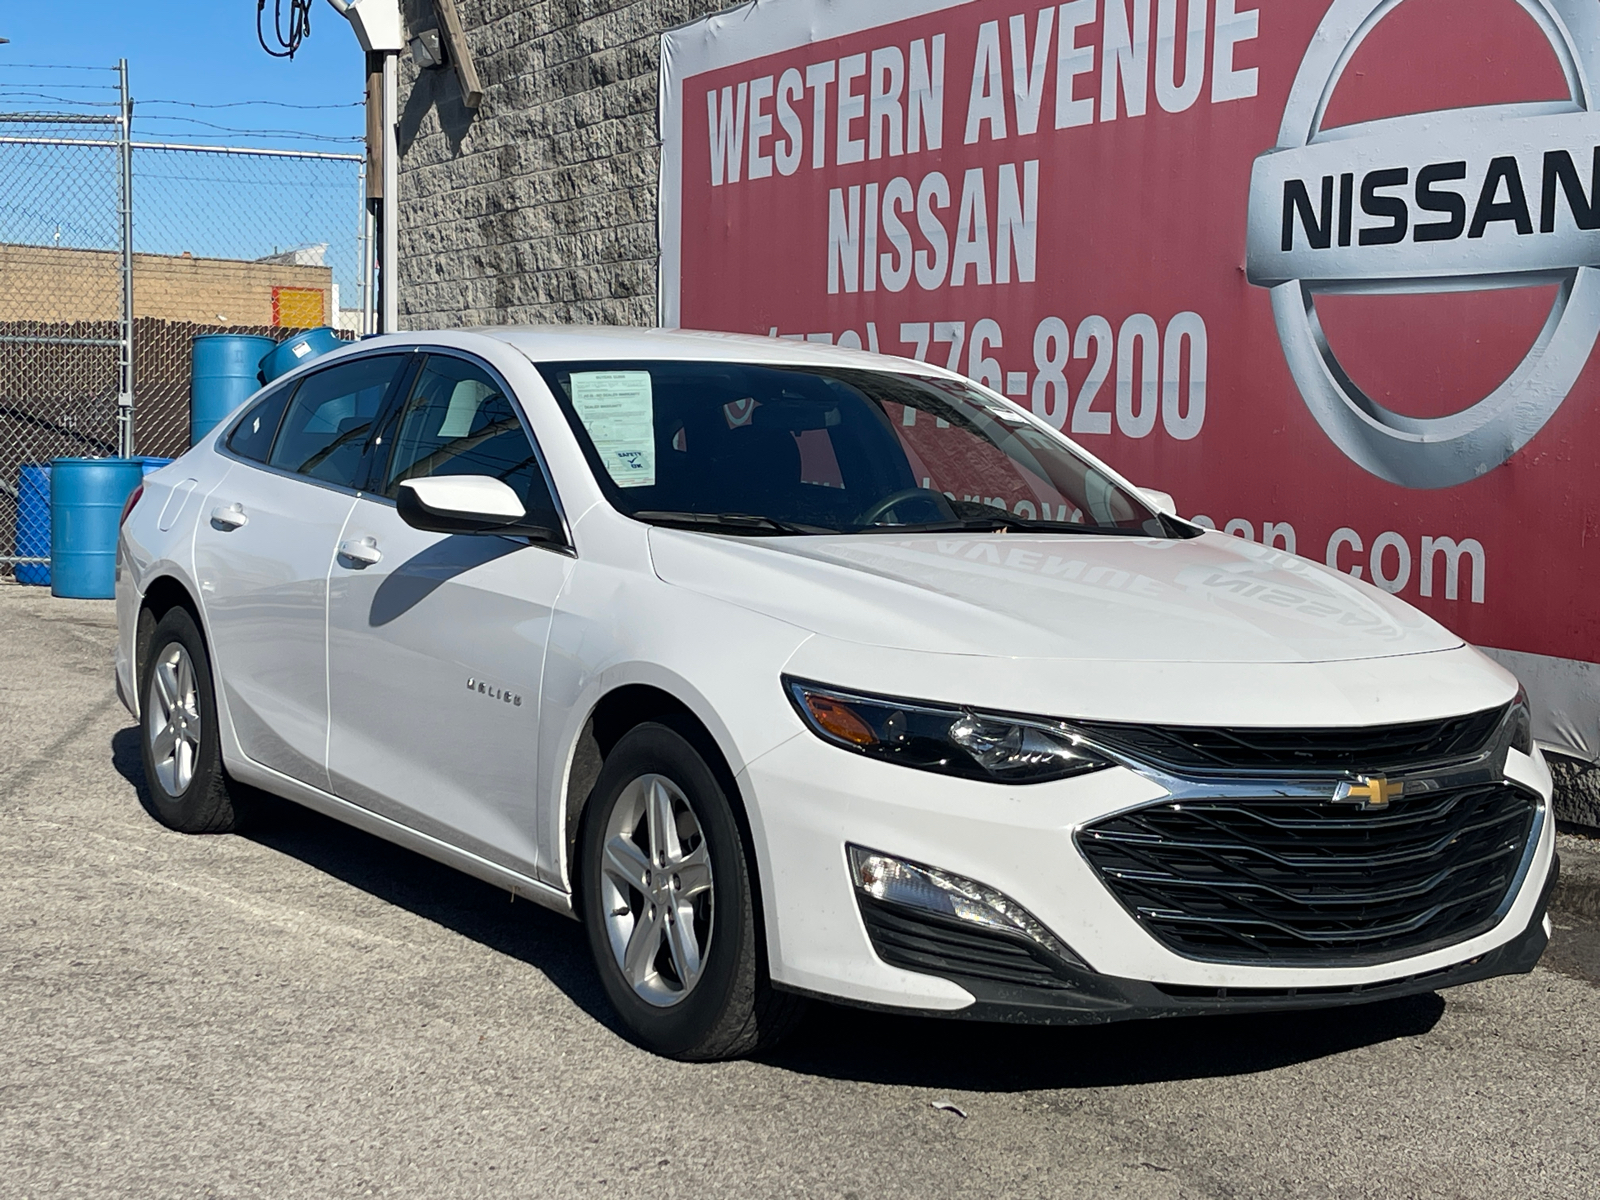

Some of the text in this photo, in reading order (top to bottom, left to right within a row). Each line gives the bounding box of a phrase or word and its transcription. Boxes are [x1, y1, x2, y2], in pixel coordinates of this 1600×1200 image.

[707, 0, 1259, 187] WESTERN AVENUE
[828, 159, 1039, 294] NISSAN
[1281, 145, 1600, 251] NISSAN
